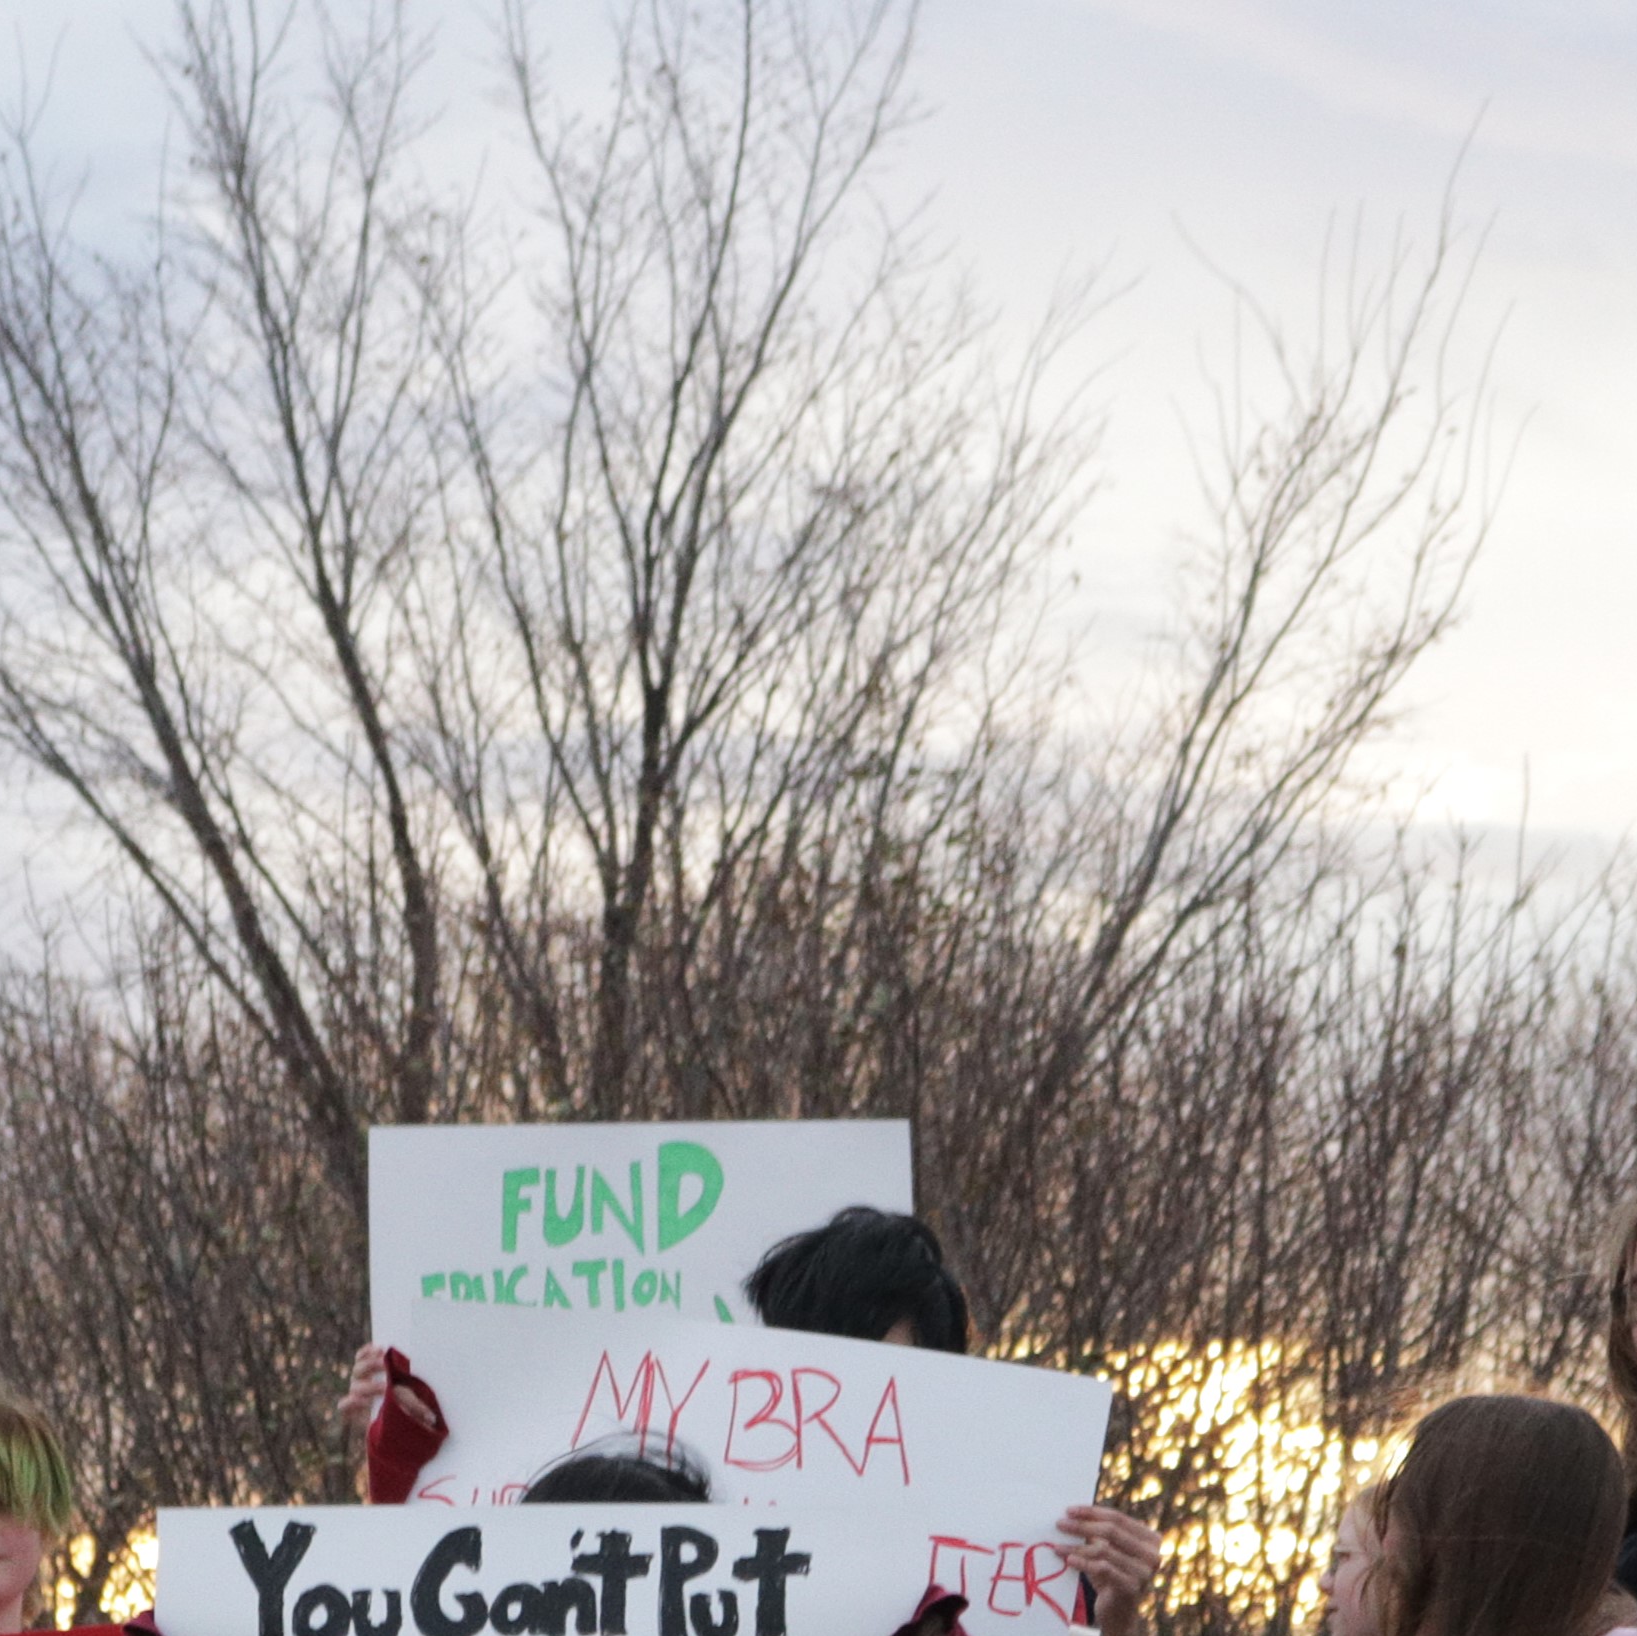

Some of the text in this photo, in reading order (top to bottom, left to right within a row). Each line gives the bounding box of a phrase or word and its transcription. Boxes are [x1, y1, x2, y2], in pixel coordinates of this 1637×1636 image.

[501, 1140, 724, 1255] FUND
[571, 1348, 910, 1487] MY BRA
